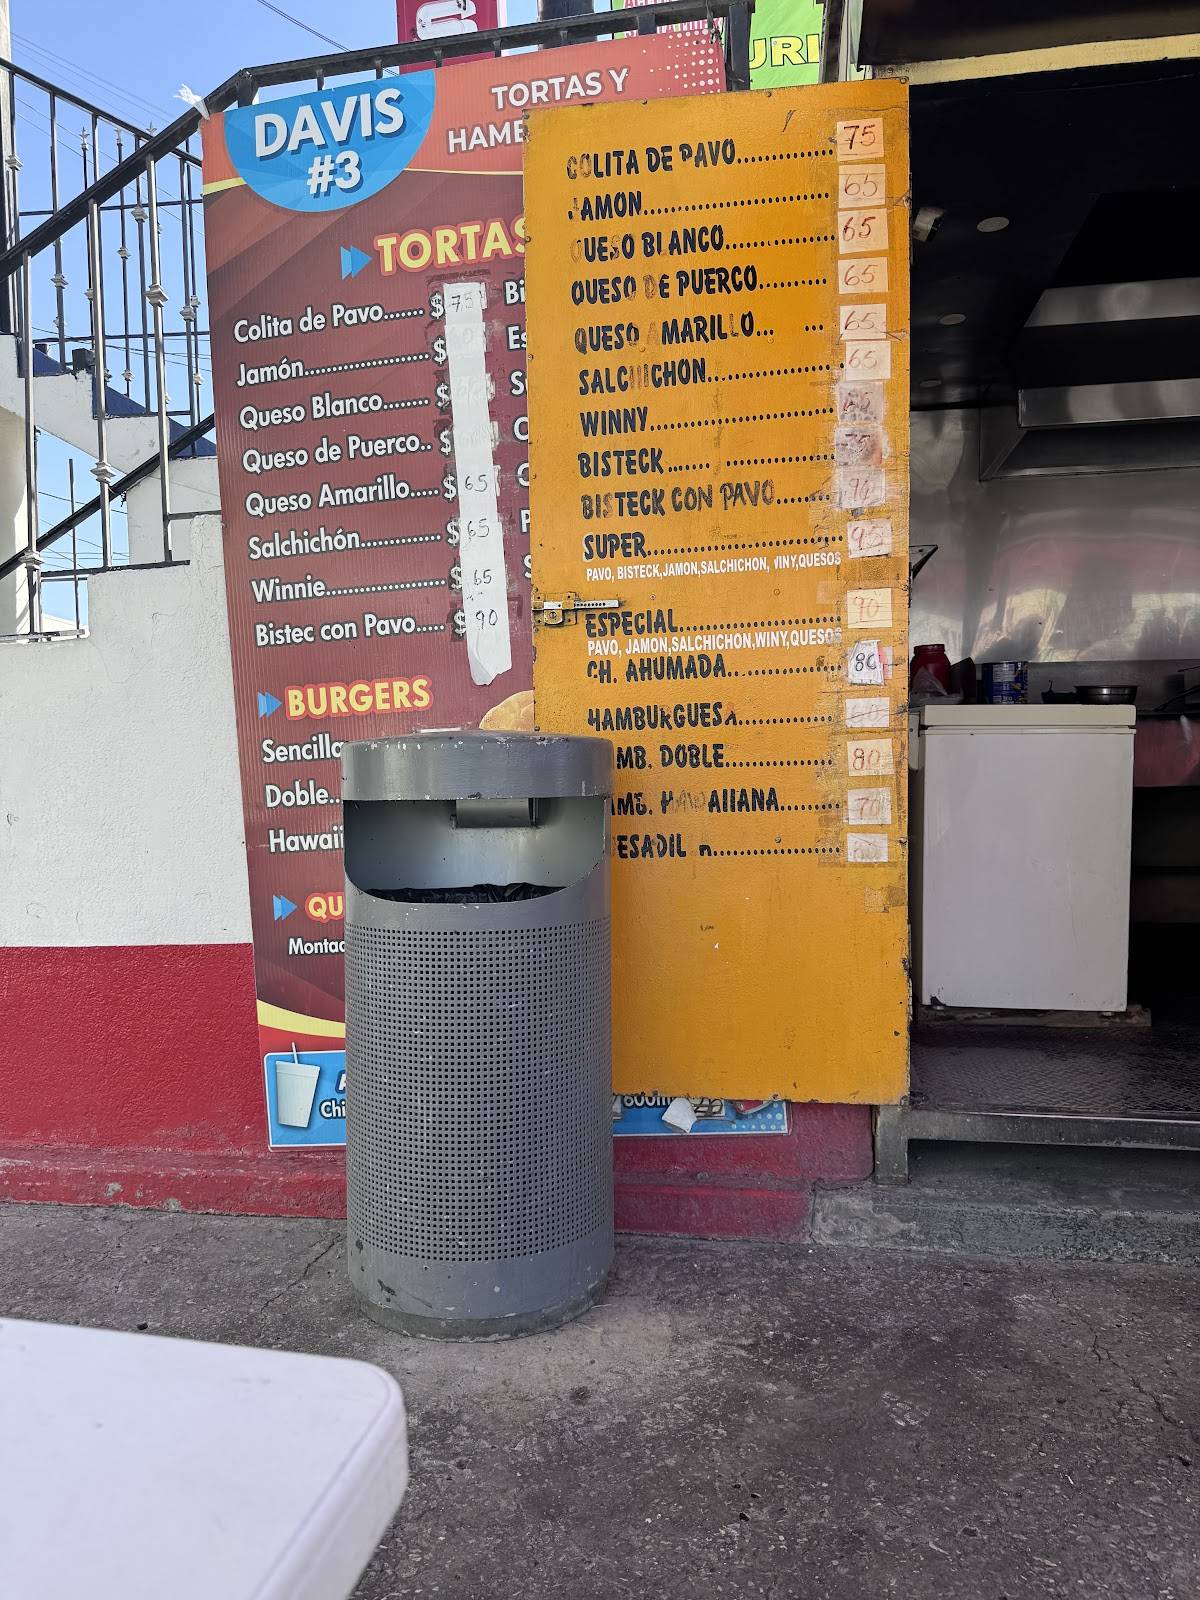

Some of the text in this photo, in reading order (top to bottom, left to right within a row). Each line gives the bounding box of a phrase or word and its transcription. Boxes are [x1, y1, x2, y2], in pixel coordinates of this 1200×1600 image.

[491, 67, 629, 109] TORTAS Y
[255, 88, 405, 159] DAVIS
[843, 124, 876, 150] 75
[306, 150, 362, 195] #3
[567, 138, 736, 179] COLITA DE PAVO
[844, 173, 878, 197] 65
[843, 216, 876, 241] 65
[376, 216, 526, 273] TORTAS
[571, 275, 637, 305] QUESO
[676, 265, 757, 297] PUERCO
[844, 264, 878, 286] 65
[233, 315, 292, 344] Colita
[299, 308, 326, 333] de
[332, 303, 384, 327] Pavo
[844, 310, 878, 330] 65
[574, 321, 640, 354] QUESO
[237, 358, 305, 387] Jamón
[848, 348, 878, 369] 65
[510, 371, 528, 395] S
[239, 405, 305, 430] Queso
[312, 392, 383, 419] Blanco
[579, 406, 648, 437] WINNY
[242, 449, 309, 474] Queso
[314, 437, 341, 463] de
[348, 432, 420, 460] Puerco
[578, 448, 664, 478] BISTECK
[245, 492, 311, 518] Queso
[318, 474, 410, 508] Amarillo
[464, 474, 488, 493] 65
[581, 478, 775, 520] BISTECK CON PAVO
[249, 526, 361, 560] Salchichón
[468, 518, 490, 538] 65
[583, 532, 648, 561] SUPER
[252, 574, 327, 604] Winnie
[473, 568, 492, 586] 65
[256, 622, 315, 647] Bistec
[320, 621, 357, 641] con
[364, 613, 416, 637] Pavo
[475, 608, 499, 630] 90
[586, 608, 678, 638] ESPECIAL
[626, 654, 726, 683] AHUMADA
[287, 679, 431, 717] BURGERS
[660, 743, 725, 768] DOBLE
[852, 748, 881, 771] 80
[308, 895, 344, 919] QU
[320, 1099, 346, 1118] Chi
